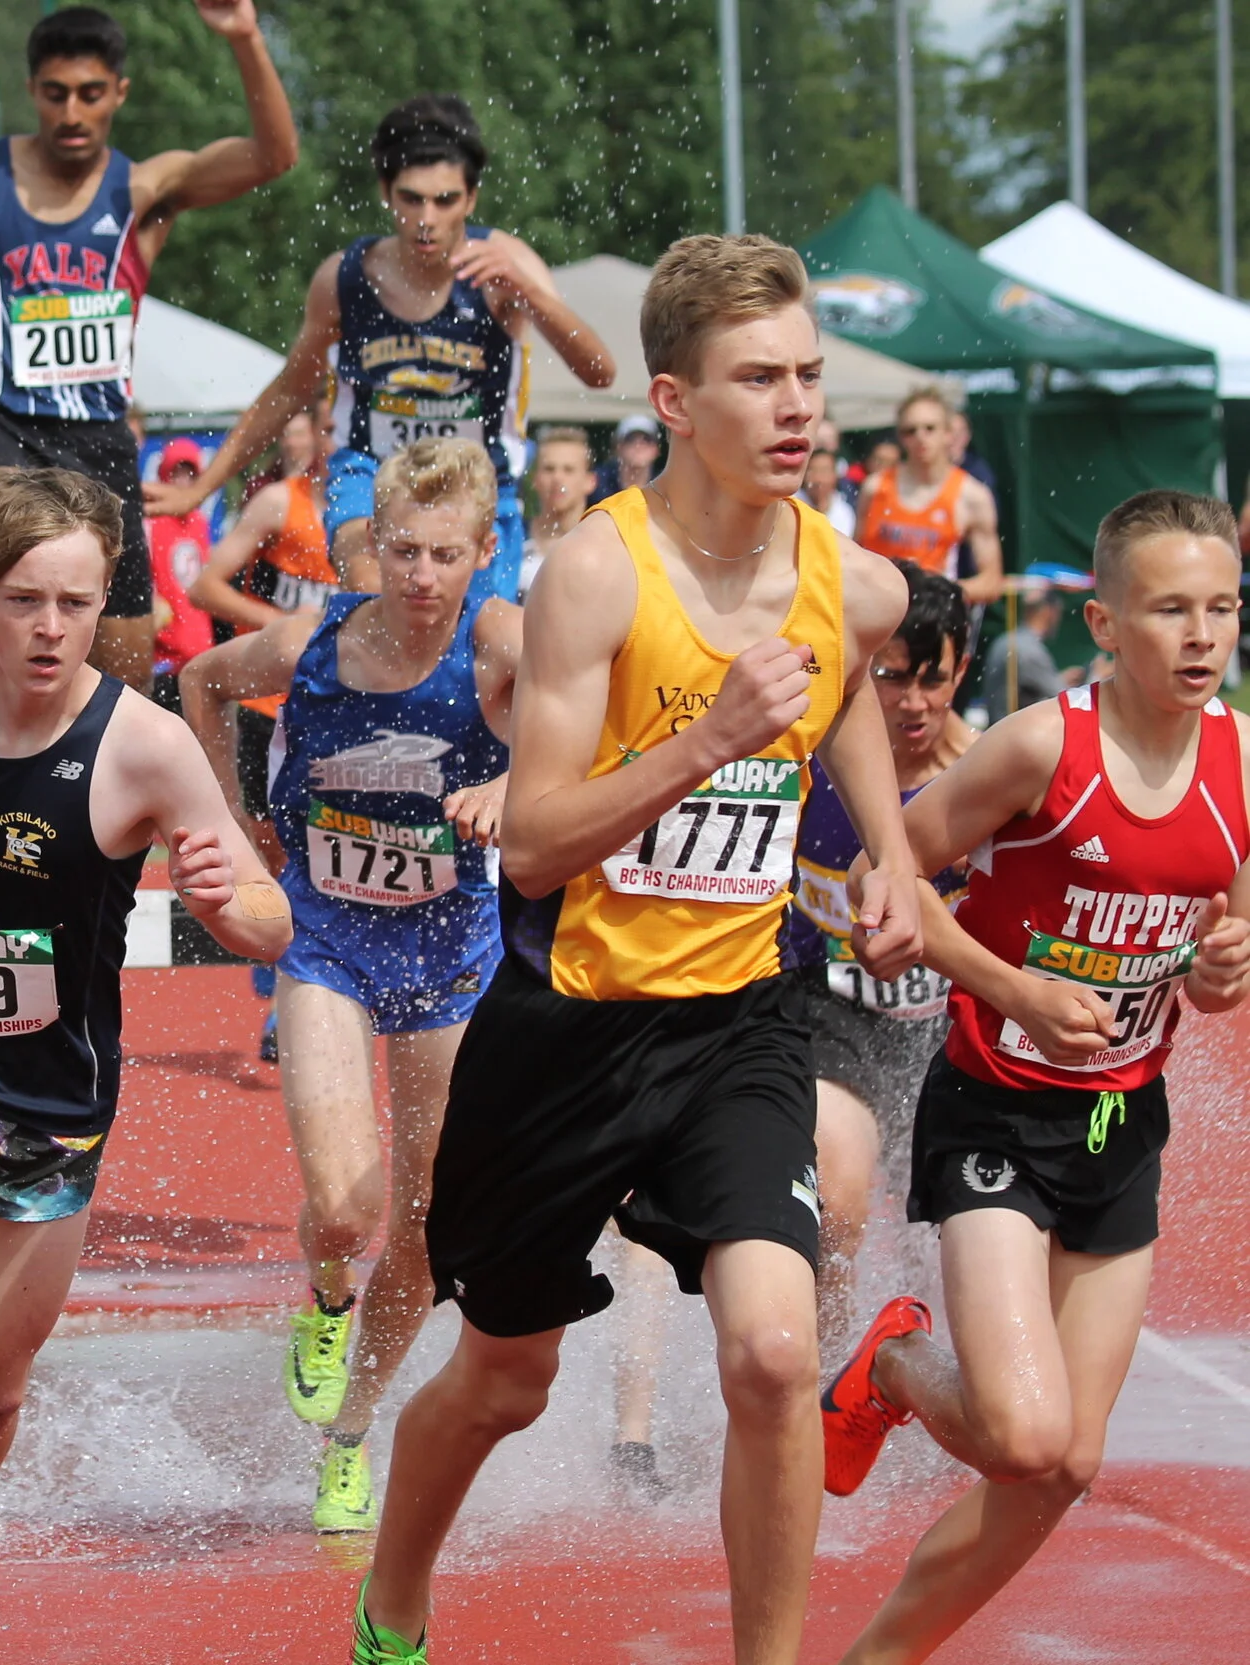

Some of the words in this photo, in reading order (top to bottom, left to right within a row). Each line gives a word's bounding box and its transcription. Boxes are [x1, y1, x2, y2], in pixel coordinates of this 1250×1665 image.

[3, 242, 107, 291] YALE
[18, 291, 127, 322] SUBWAY
[26, 322, 116, 368] 2001
[376, 393, 474, 419] SUBWAY
[800, 662, 822, 675] das
[325, 760, 442, 796] ROCKETS
[706, 760, 799, 793] WAY
[315, 806, 445, 851] SUBWAY
[637, 801, 782, 872] 1777
[323, 834, 435, 892] 1721
[1070, 848, 1110, 864] adidas
[19, 867, 26, 875] &
[26, 868, 50, 880] FIELD
[321, 879, 336, 891] BC
[619, 867, 639, 885] BC
[643, 870, 663, 887] HS
[667, 873, 777, 896] CHAMPIONSHIPS
[1038, 940, 1191, 984] SUBWAY
[1088, 1036, 1151, 1066] MPIONSHIPS
